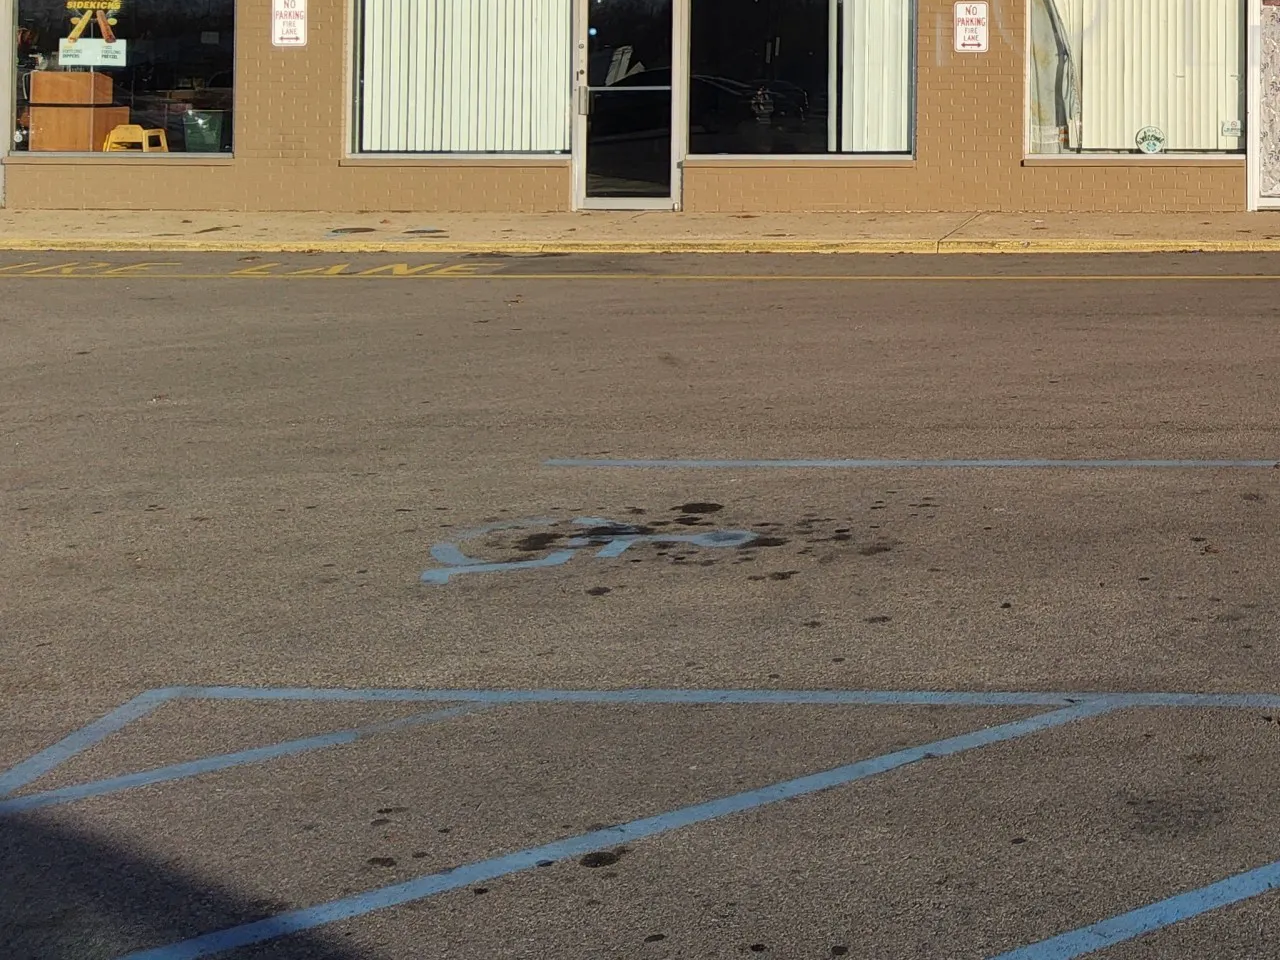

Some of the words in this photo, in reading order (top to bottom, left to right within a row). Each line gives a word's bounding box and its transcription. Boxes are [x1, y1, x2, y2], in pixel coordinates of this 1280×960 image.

[66, 1, 121, 9] SIDEKICKS
[283, 0, 296, 9] NO
[275, 10, 304, 20] PARKING
[965, 6, 978, 16] NO
[282, 20, 297, 28] FIRE
[957, 17, 986, 27] PARKING
[281, 28, 297, 36] LANE
[964, 27, 978, 35] FIRE
